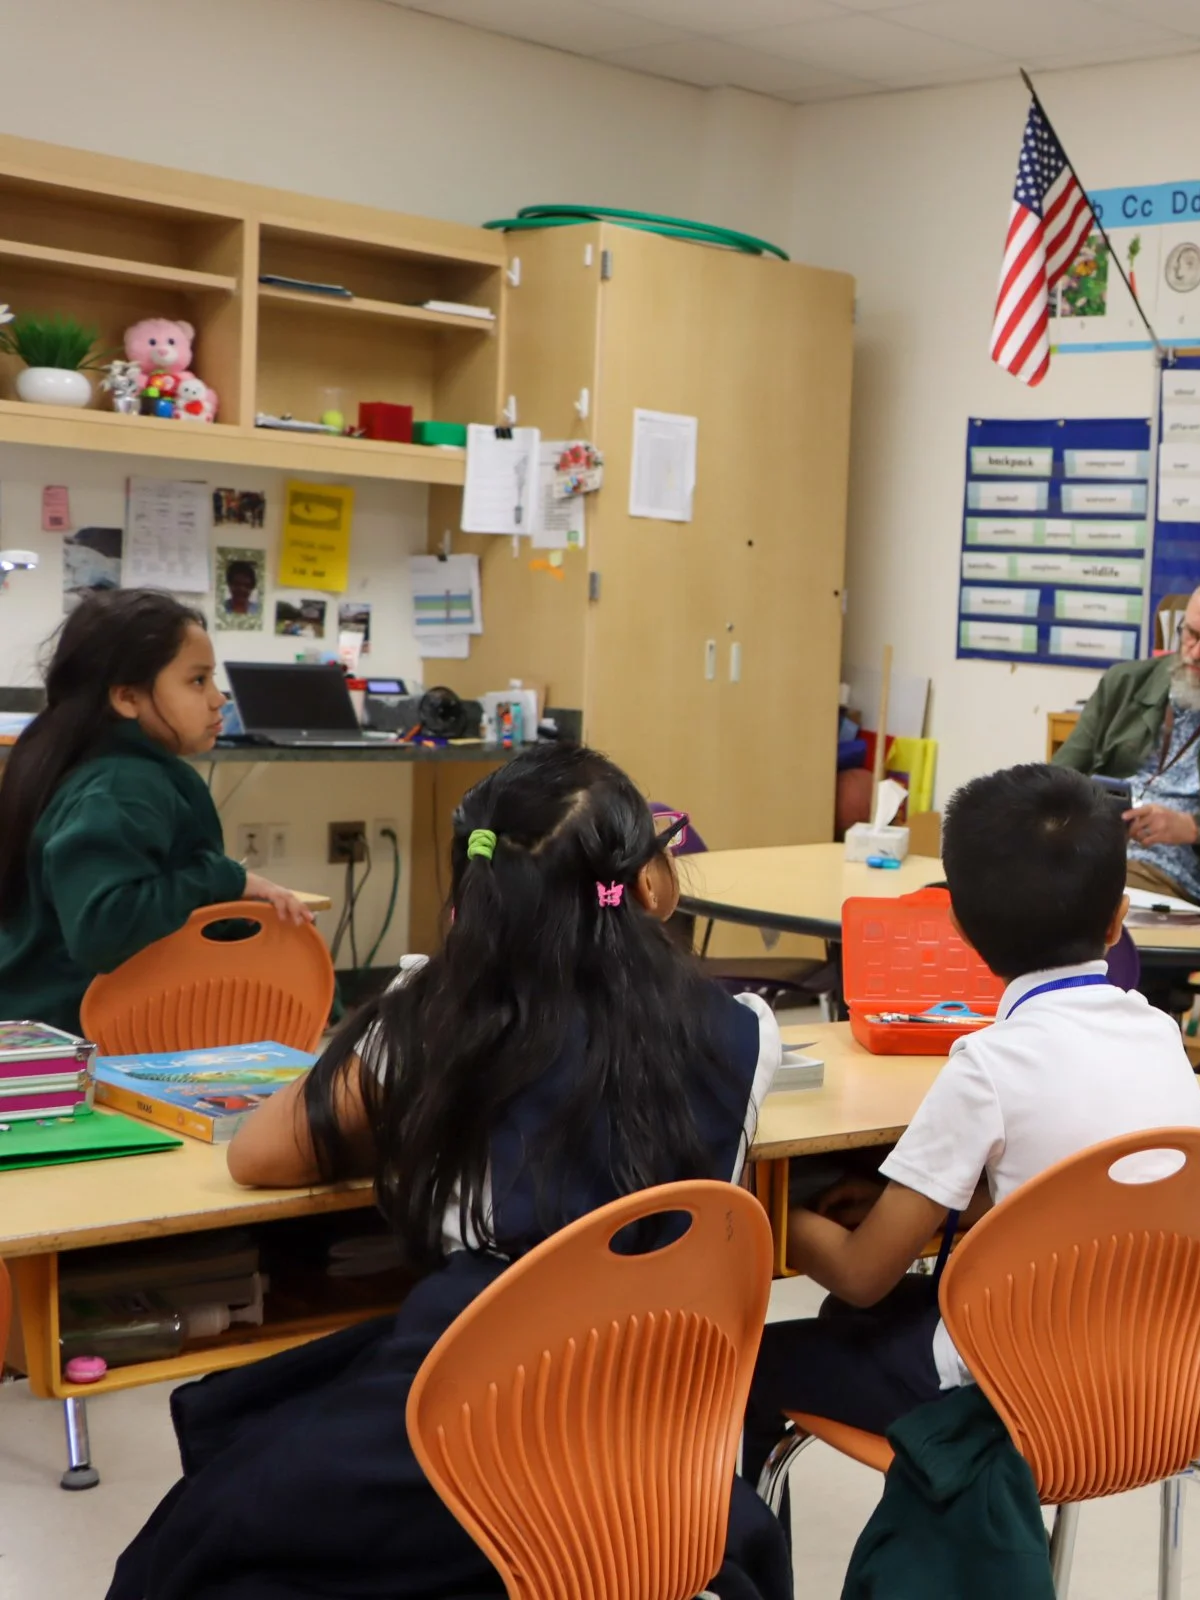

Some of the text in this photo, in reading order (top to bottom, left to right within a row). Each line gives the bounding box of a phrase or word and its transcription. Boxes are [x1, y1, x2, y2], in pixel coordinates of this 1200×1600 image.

[1121, 195, 1154, 219] Cc
[988, 455, 1034, 468] backpack
[1082, 566, 1120, 578] wildlife
